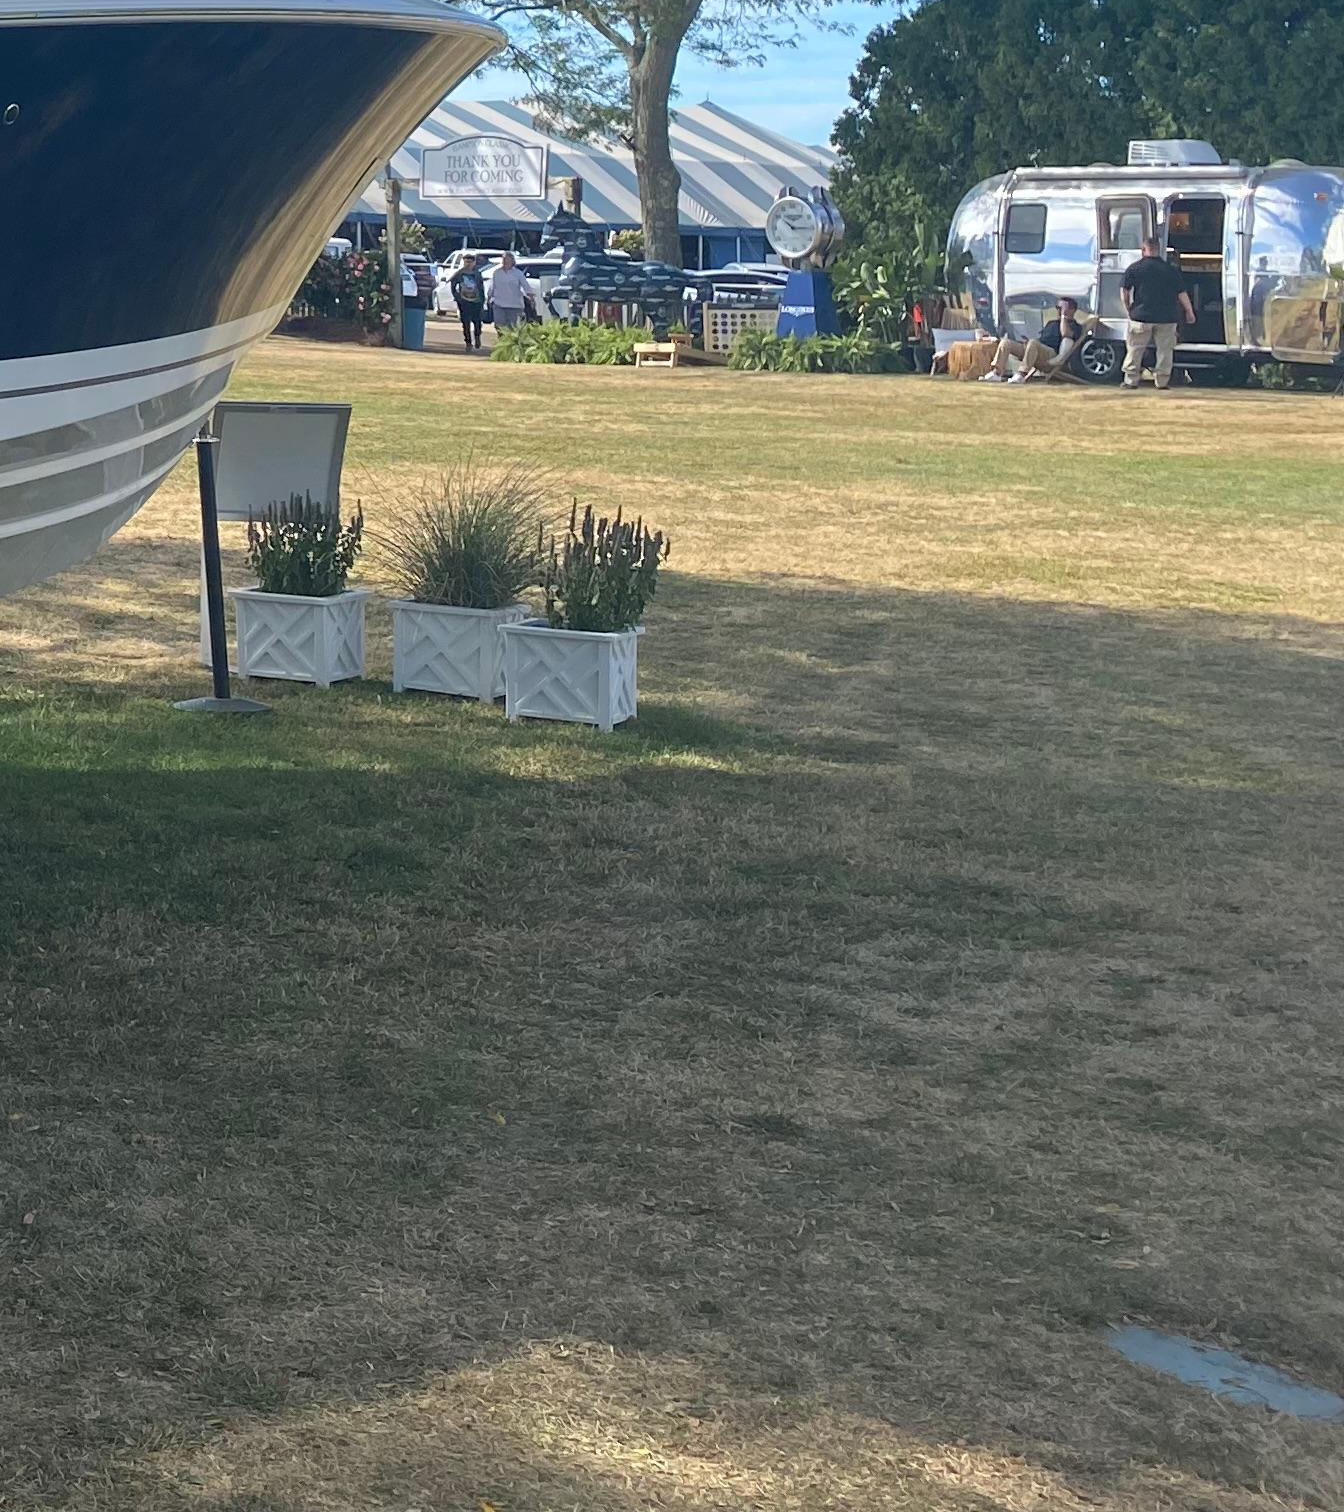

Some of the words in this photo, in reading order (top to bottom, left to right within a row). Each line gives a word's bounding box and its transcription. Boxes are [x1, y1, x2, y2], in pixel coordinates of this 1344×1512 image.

[446, 155, 490, 168] THANK
[492, 154, 521, 168] YOU
[444, 171, 468, 183] FOR
[470, 170, 524, 183] COMING
